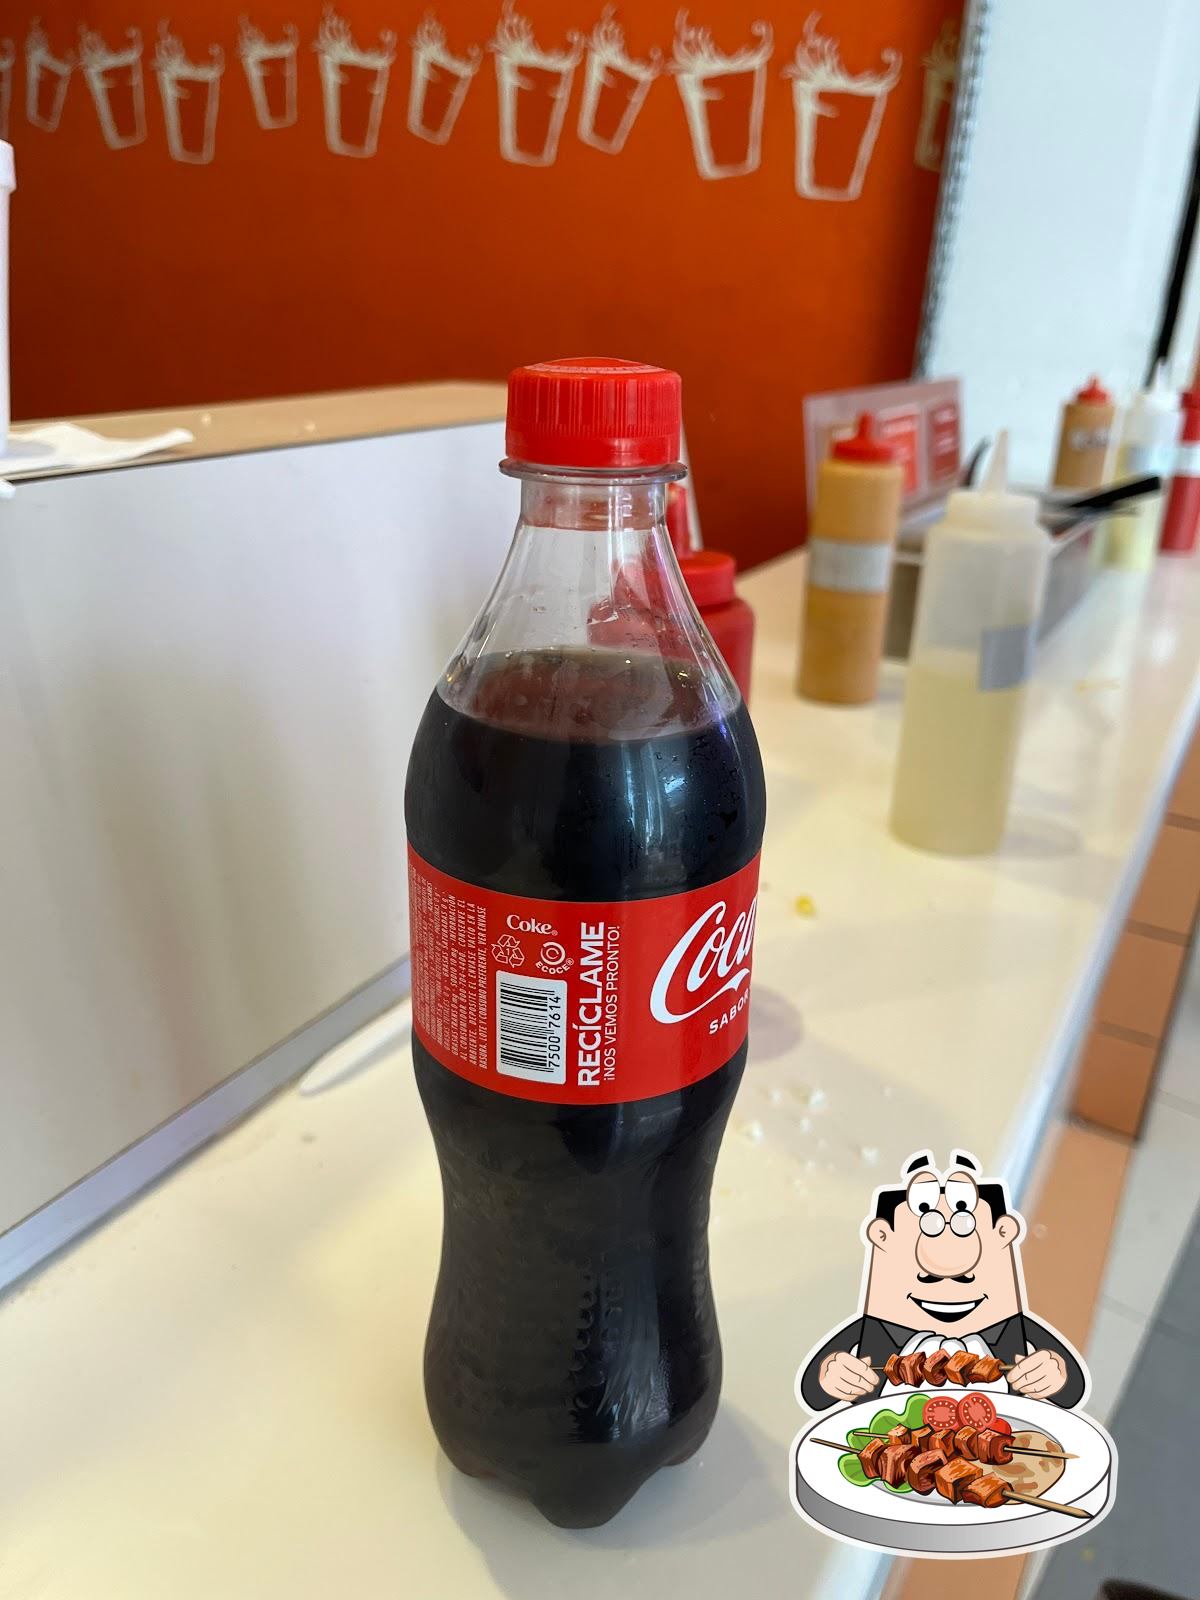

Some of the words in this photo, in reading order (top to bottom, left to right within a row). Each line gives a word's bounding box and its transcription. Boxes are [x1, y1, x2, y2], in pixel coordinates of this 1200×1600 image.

[605, 925, 621, 991] PRONTO!
[548, 995, 561, 1028] 7614
[572, 921, 605, 1086] RECÍCLAME
[605, 994, 618, 1046] VEMOS
[548, 1036, 561, 1068] 7500
[603, 1047, 616, 1081] ¡NOS
